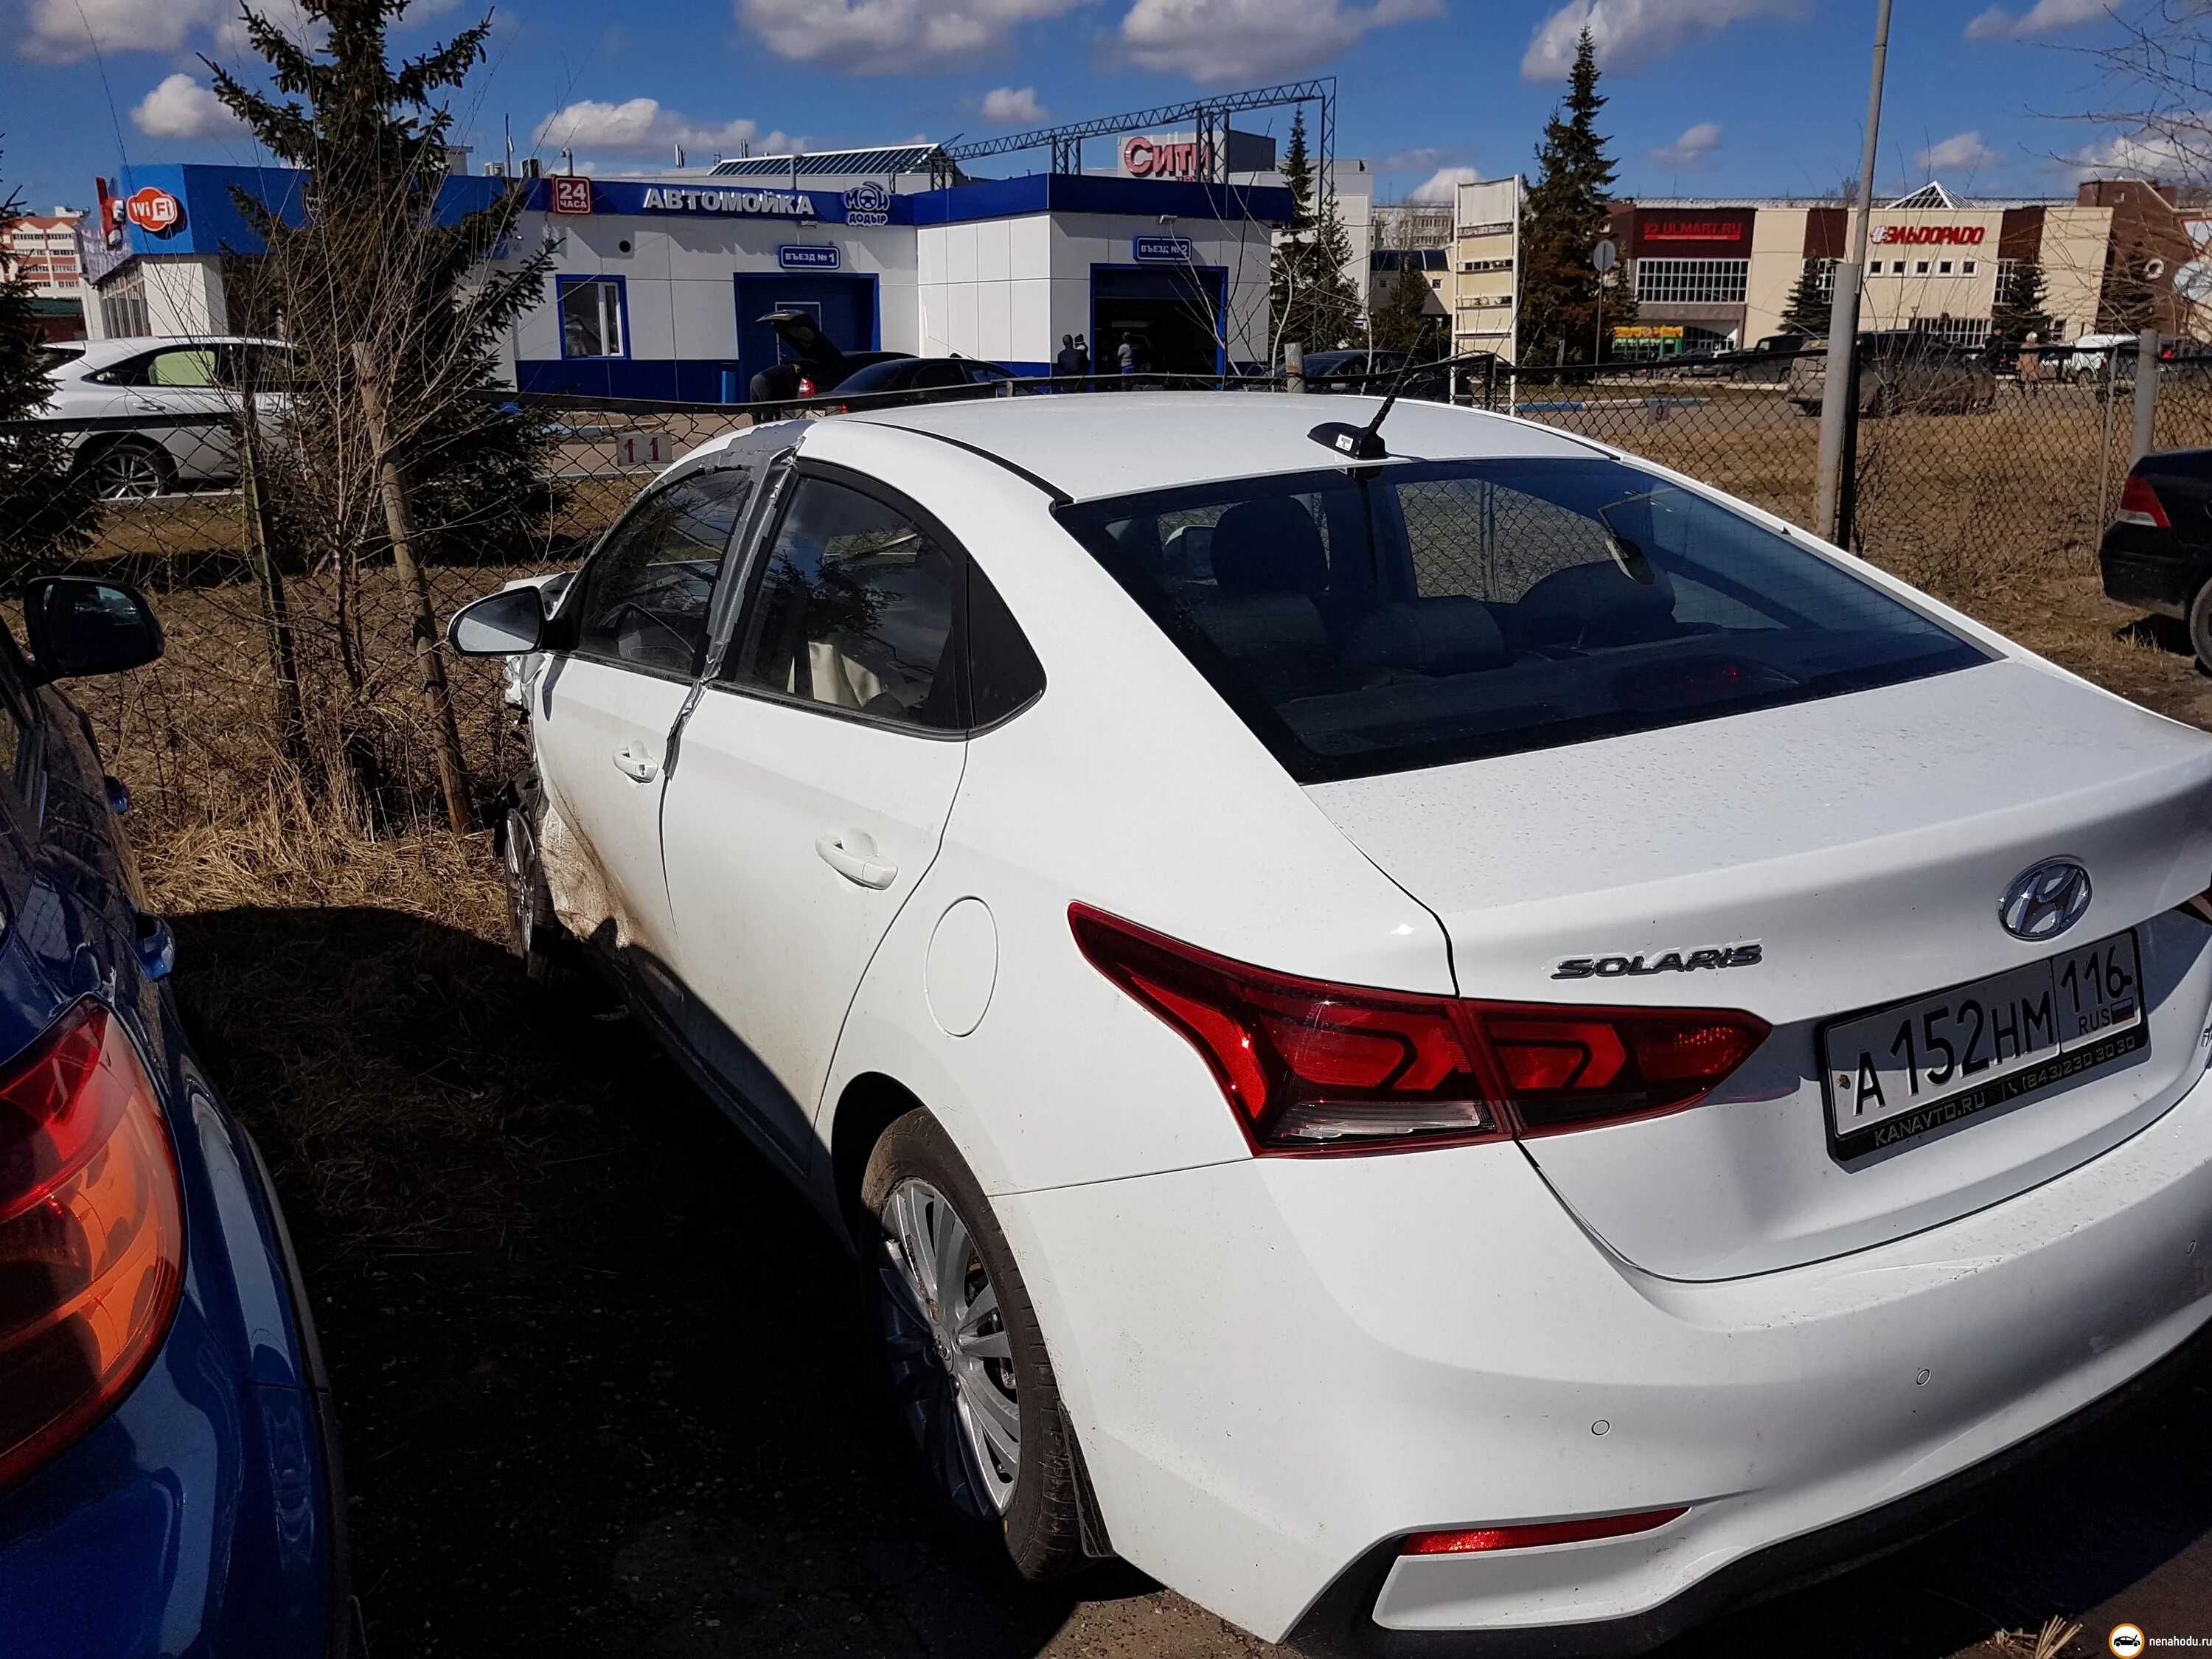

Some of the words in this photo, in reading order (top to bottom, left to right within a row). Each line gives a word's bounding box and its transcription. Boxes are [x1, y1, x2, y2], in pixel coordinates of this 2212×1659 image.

[560, 183, 587, 200] 24
[560, 200, 588, 209] ЧАСА
[644, 188, 815, 215] АВТОМОЙКА
[848, 212, 888, 226] ДОДЫР
[1663, 223, 1742, 234] ULMART.RU
[785, 253, 815, 262] ВЪЕЗД
[1141, 245, 1169, 254] ВЪЕЗД
[1655, 405, 1664, 422] 9
[1550, 943, 1763, 980] SOLARIS
[2060, 945, 2126, 1013] 116
[2079, 1008, 2111, 1036] RUS
[1874, 1091, 1986, 1147] KANAVTO.RU
